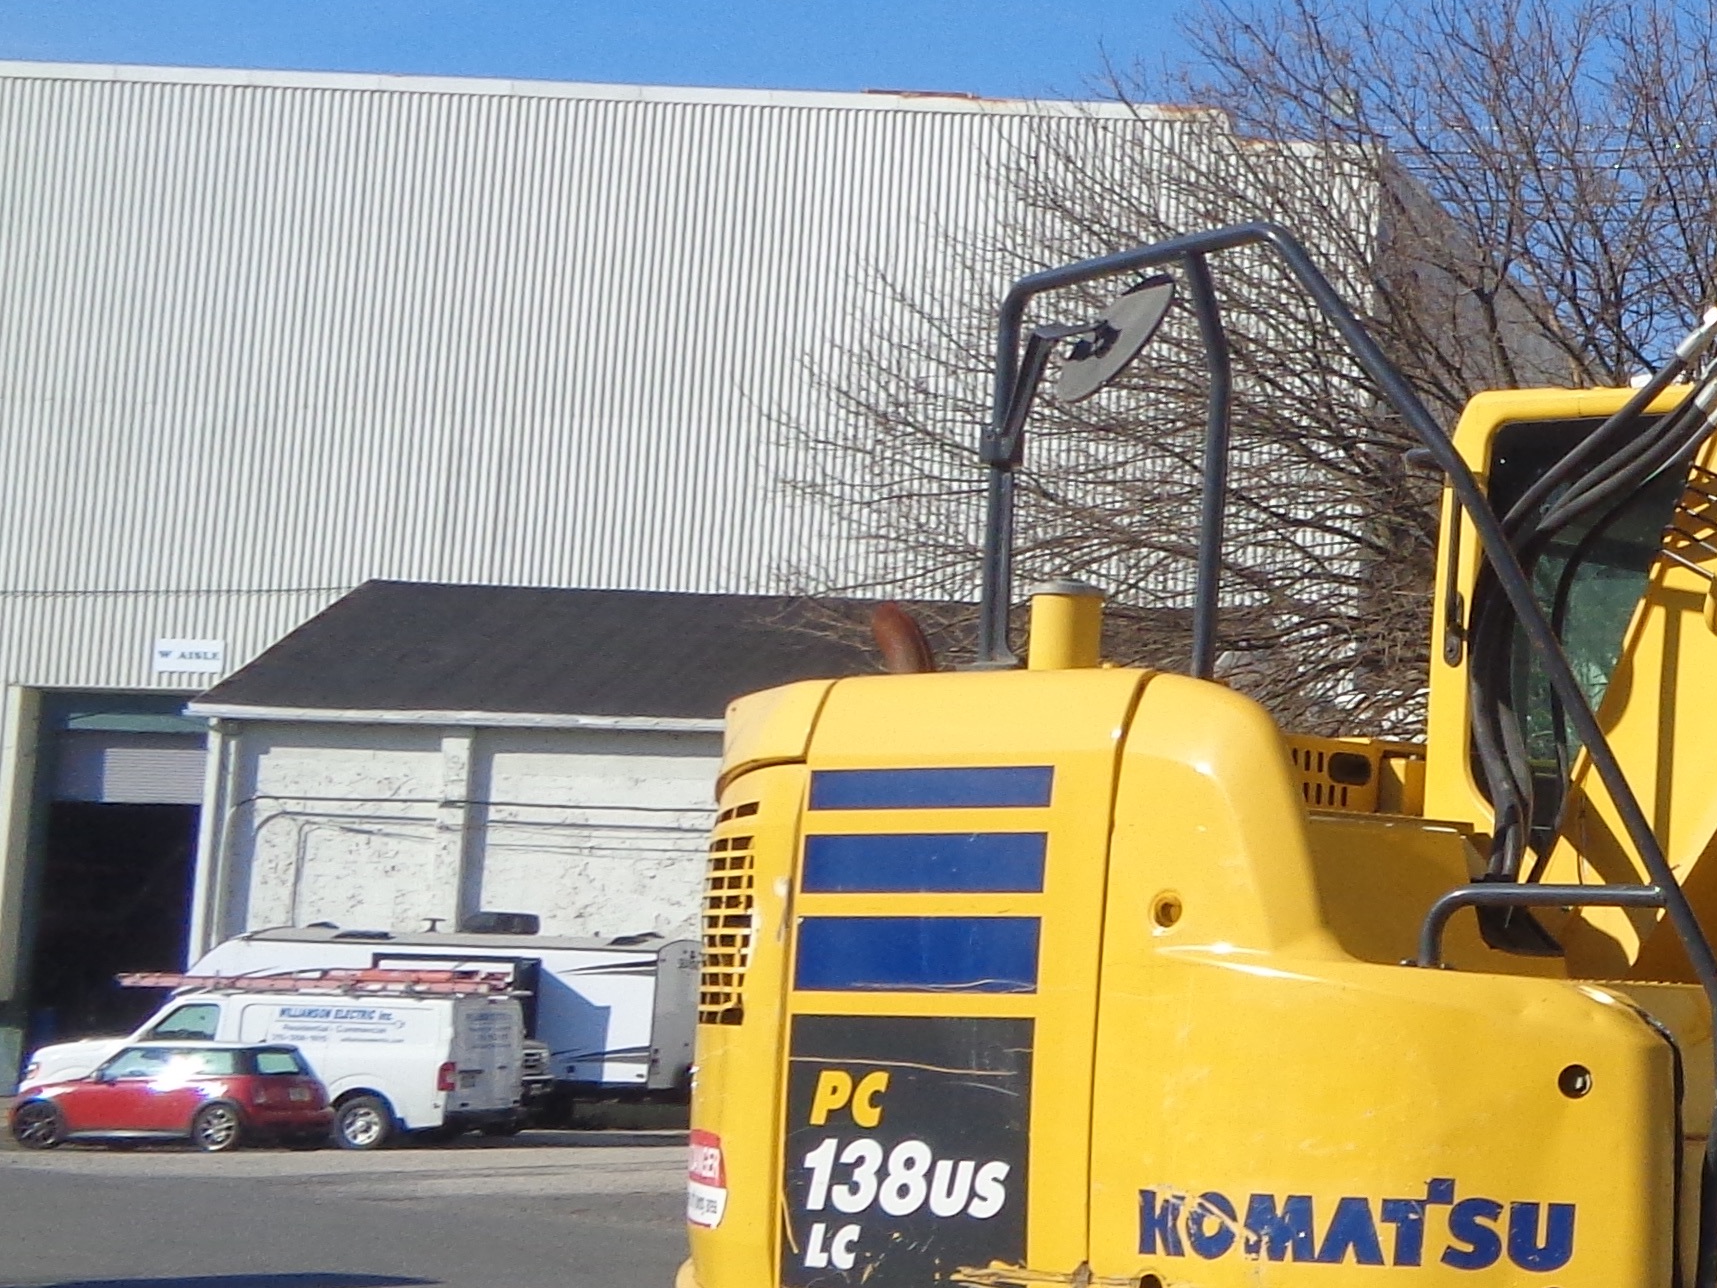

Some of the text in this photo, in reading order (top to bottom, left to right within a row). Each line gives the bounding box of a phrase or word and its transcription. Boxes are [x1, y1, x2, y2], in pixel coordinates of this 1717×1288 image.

[158, 650, 220, 661] W AISLE
[333, 1008, 376, 1020] ELECTRIC
[809, 1069, 890, 1128] PC
[802, 1137, 1011, 1219] 138US
[804, 1222, 861, 1270] LC
[1138, 1177, 1576, 1272] KOMATSU
